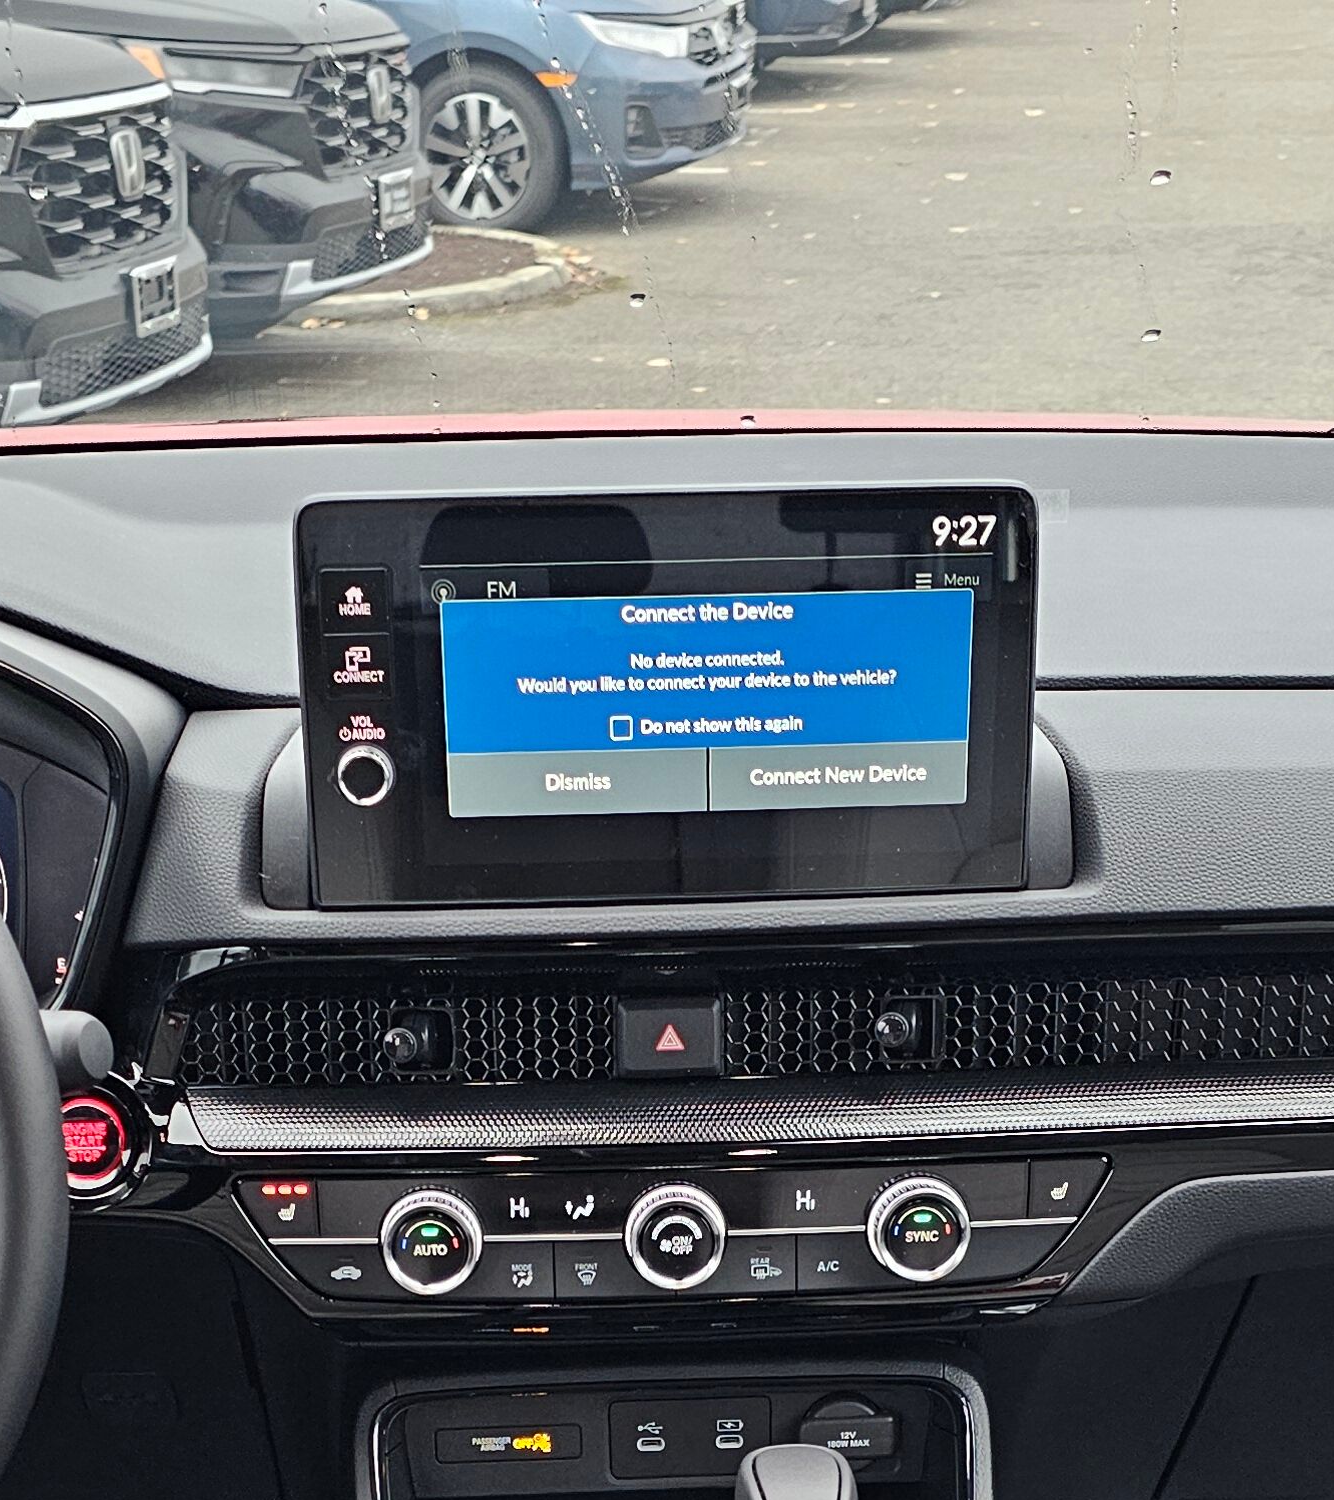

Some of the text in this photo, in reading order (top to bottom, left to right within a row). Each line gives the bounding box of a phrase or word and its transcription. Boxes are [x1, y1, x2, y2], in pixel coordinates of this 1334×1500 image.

[932, 515, 997, 547] 9:27
[944, 573, 980, 586] Menu
[487, 581, 517, 598] FM
[338, 604, 371, 616] HOME
[621, 601, 794, 624] Connect the Device
[630, 649, 785, 669] No device connected.
[333, 670, 385, 683] CONNECT
[517, 669, 897, 695] Would you like to connect your device to the vehicle?
[350, 715, 374, 728] VOL
[640, 715, 803, 735] Do not show this again
[351, 727, 386, 740] AUDIO
[749, 764, 928, 787] Connect New Device
[545, 773, 612, 792] Dismiss
[62, 1122, 107, 1137] ENGINE
[65, 1136, 104, 1147] START
[68, 1150, 101, 1162] STOP
[905, 1230, 939, 1243] SYNC
[413, 1244, 448, 1256] AUTO
[672, 1245, 692, 1256] OFF
[512, 1263, 533, 1272] MODE
[575, 1263, 598, 1271] FRONT
[817, 1261, 840, 1272] A/C
[840, 1431, 857, 1439] 12V
[827, 1439, 870, 1448] 180W MAX
